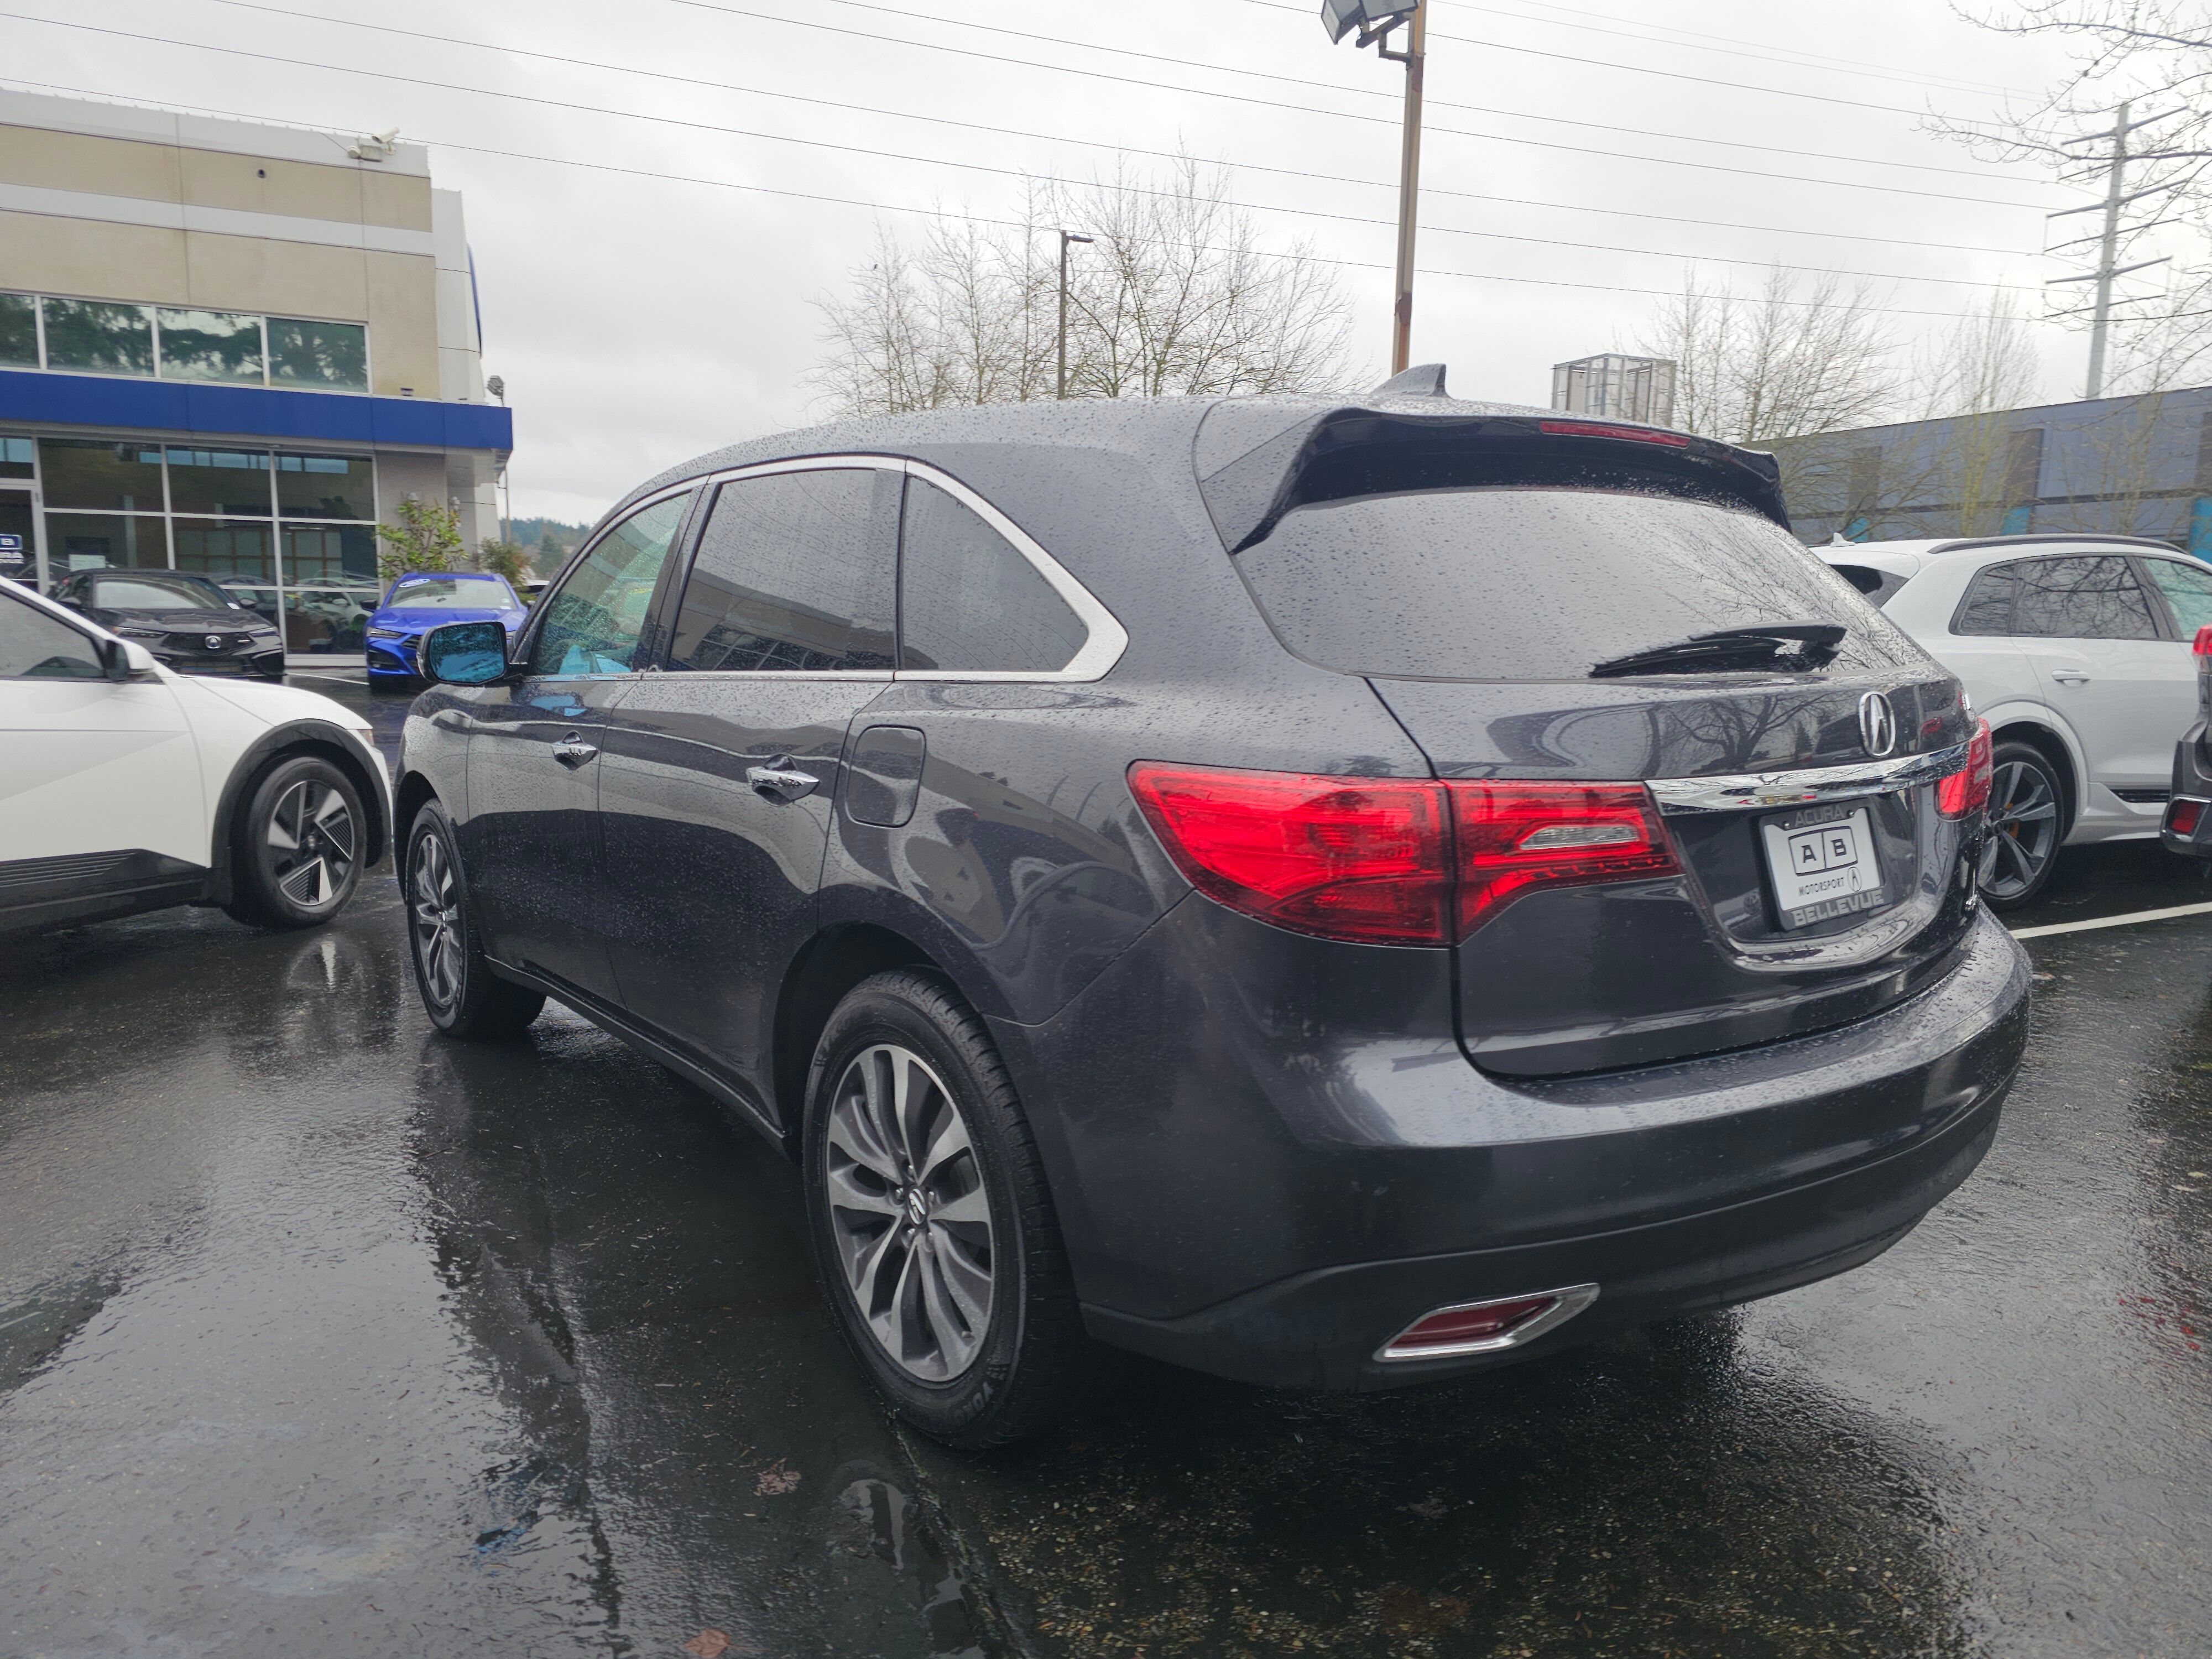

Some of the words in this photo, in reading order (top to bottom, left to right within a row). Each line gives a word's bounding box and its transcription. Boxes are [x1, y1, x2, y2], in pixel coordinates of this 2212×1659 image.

[1795, 805, 1845, 826] ACURA
[1798, 877, 1844, 896] MOTORSPORT
[1791, 889, 1884, 927] BELLEVUE
